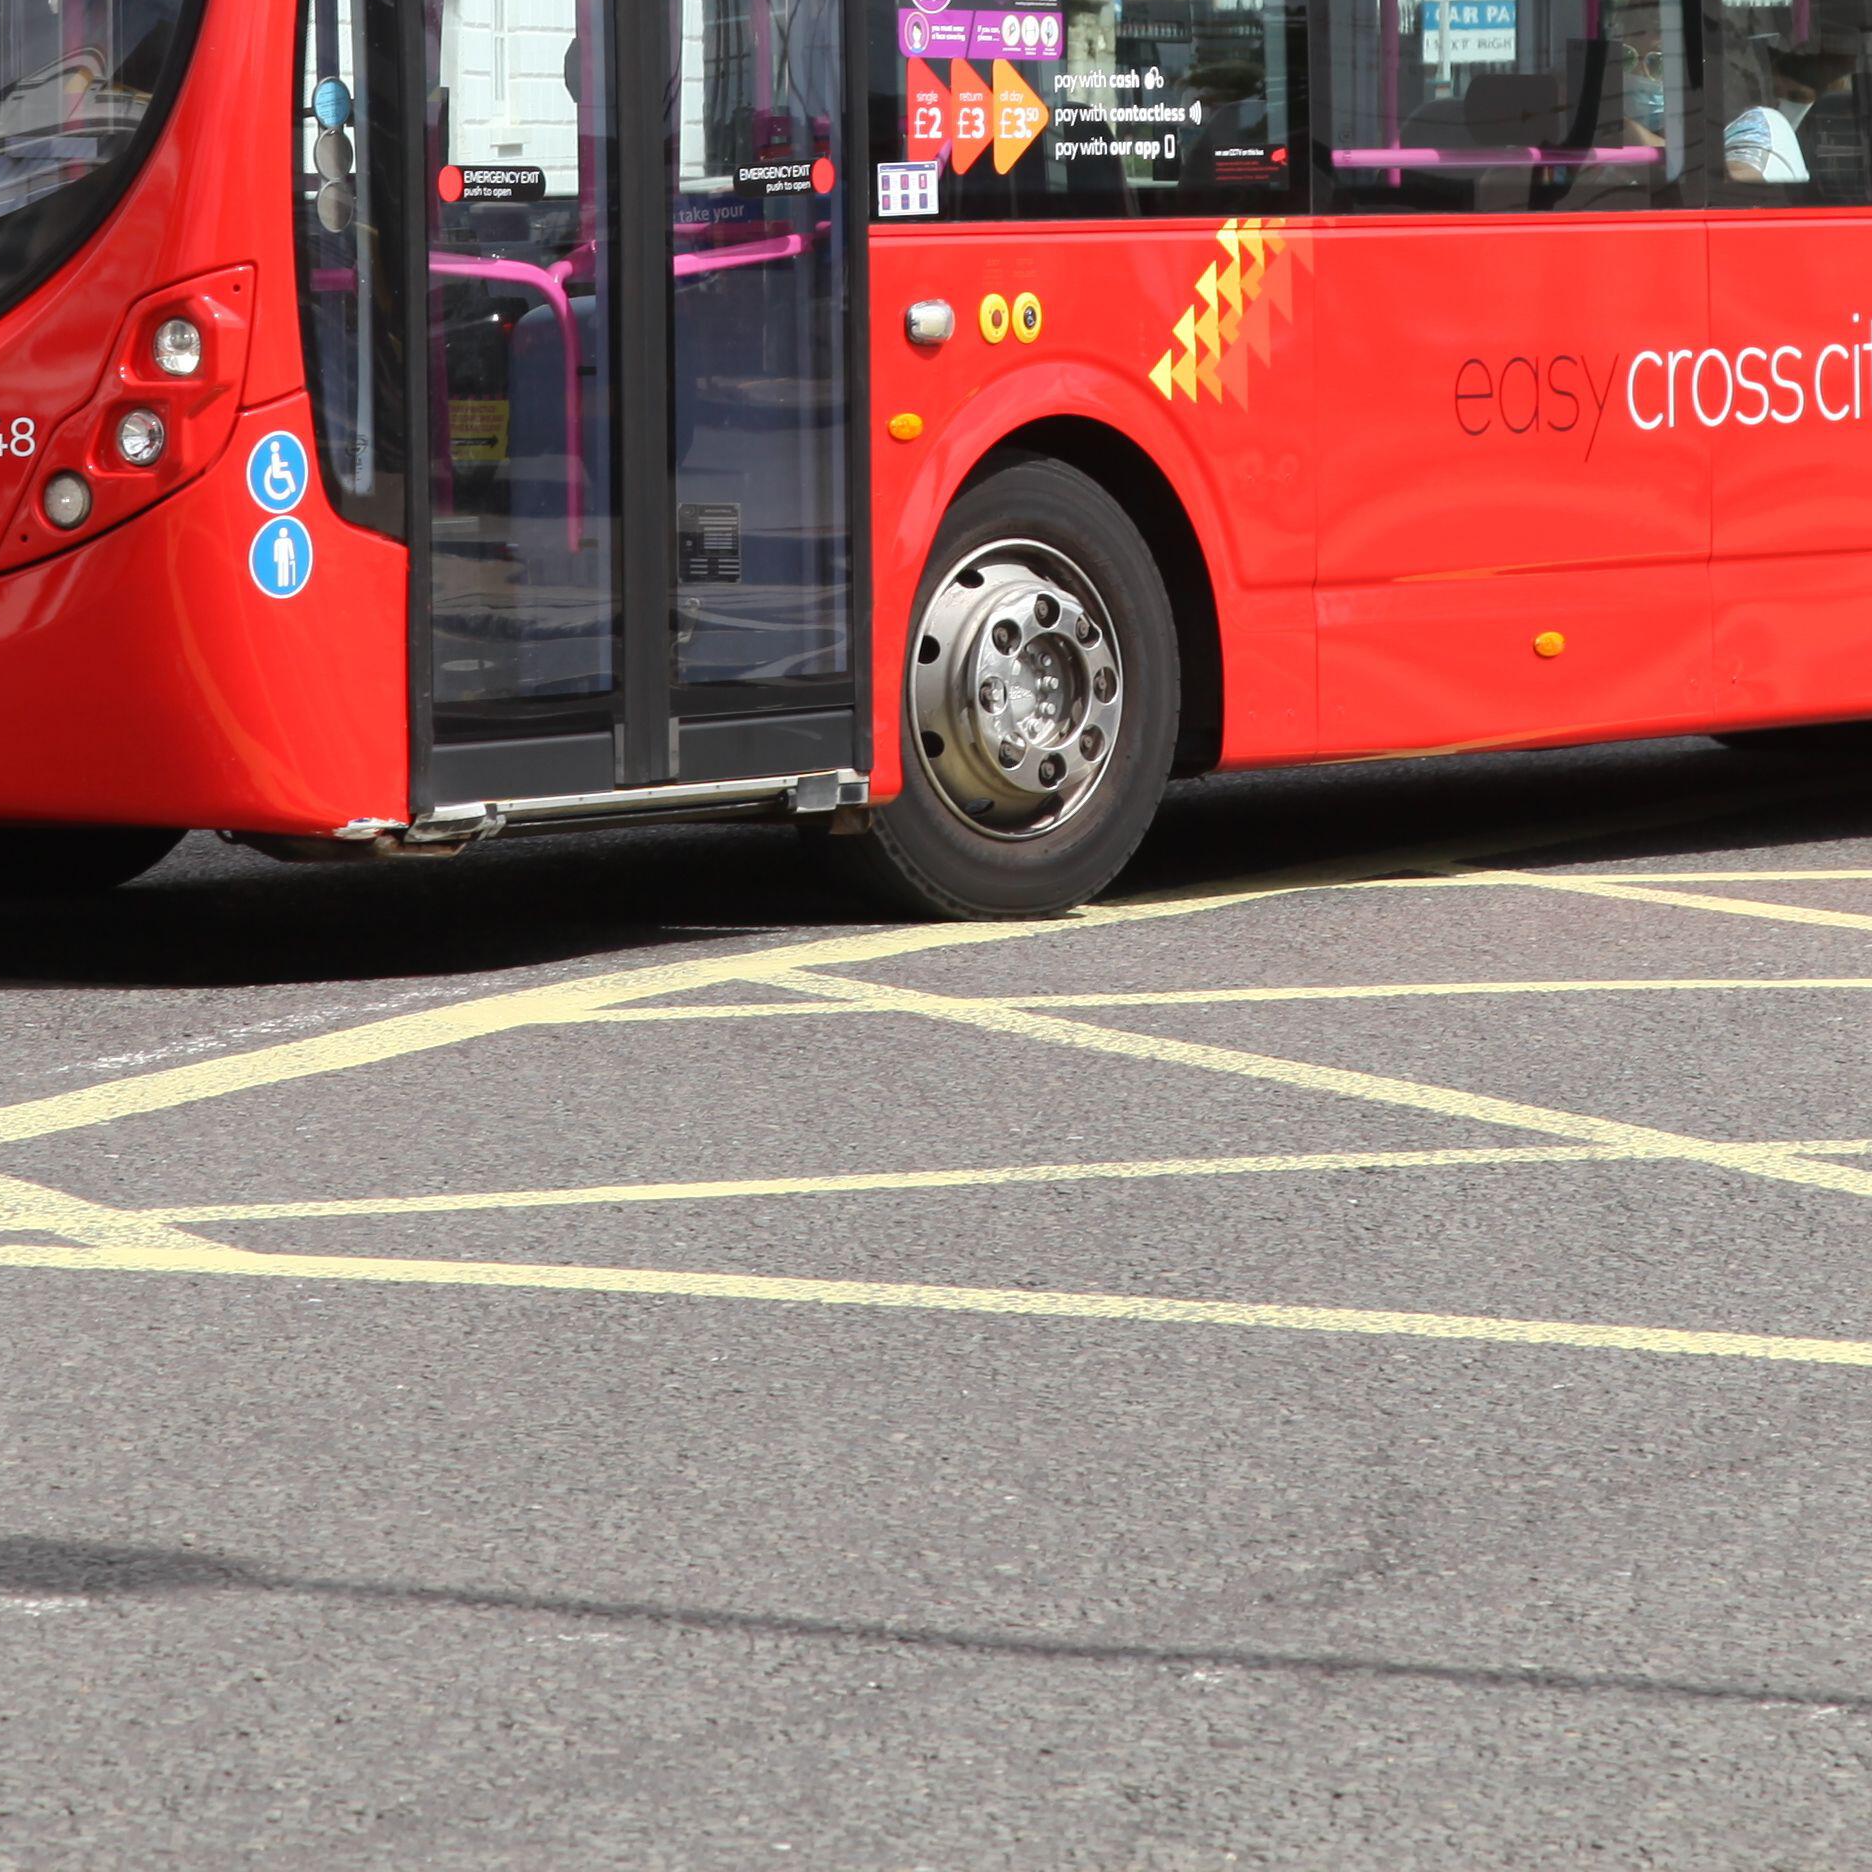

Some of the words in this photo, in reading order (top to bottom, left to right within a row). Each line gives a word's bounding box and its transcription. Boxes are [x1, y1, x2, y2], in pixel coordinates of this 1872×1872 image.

[1486, 4, 1516, 24] PA
[1054, 74, 1078, 93] pay
[1078, 70, 1107, 88] with
[1109, 69, 1140, 88] cash
[916, 91, 938, 104] single
[959, 91, 984, 103] return
[1000, 92, 1010, 102] all
[1011, 92, 1024, 104] day
[914, 107, 943, 139] £2
[957, 107, 985, 139] £3
[1054, 107, 1078, 127] pay
[1079, 103, 1108, 122] with
[1109, 102, 1186, 123] contactless
[1055, 142, 1079, 161] pay
[1079, 137, 1108, 156] with
[1110, 141, 1133, 156] our
[1134, 141, 1160, 159] app
[463, 170, 520, 185] EMERGENCY
[520, 171, 540, 185] EXIT
[739, 165, 792, 181] EMERGENCY
[792, 163, 810, 179] EXIT
[463, 187, 482, 199] push
[483, 187, 491, 197] to
[492, 188, 512, 200] open
[766, 182, 785, 194] push
[785, 181, 792, 192] to
[793, 180, 811, 193] open
[679, 206, 710, 223] take
[713, 205, 745, 223] your
[1454, 354, 1619, 463] easy
